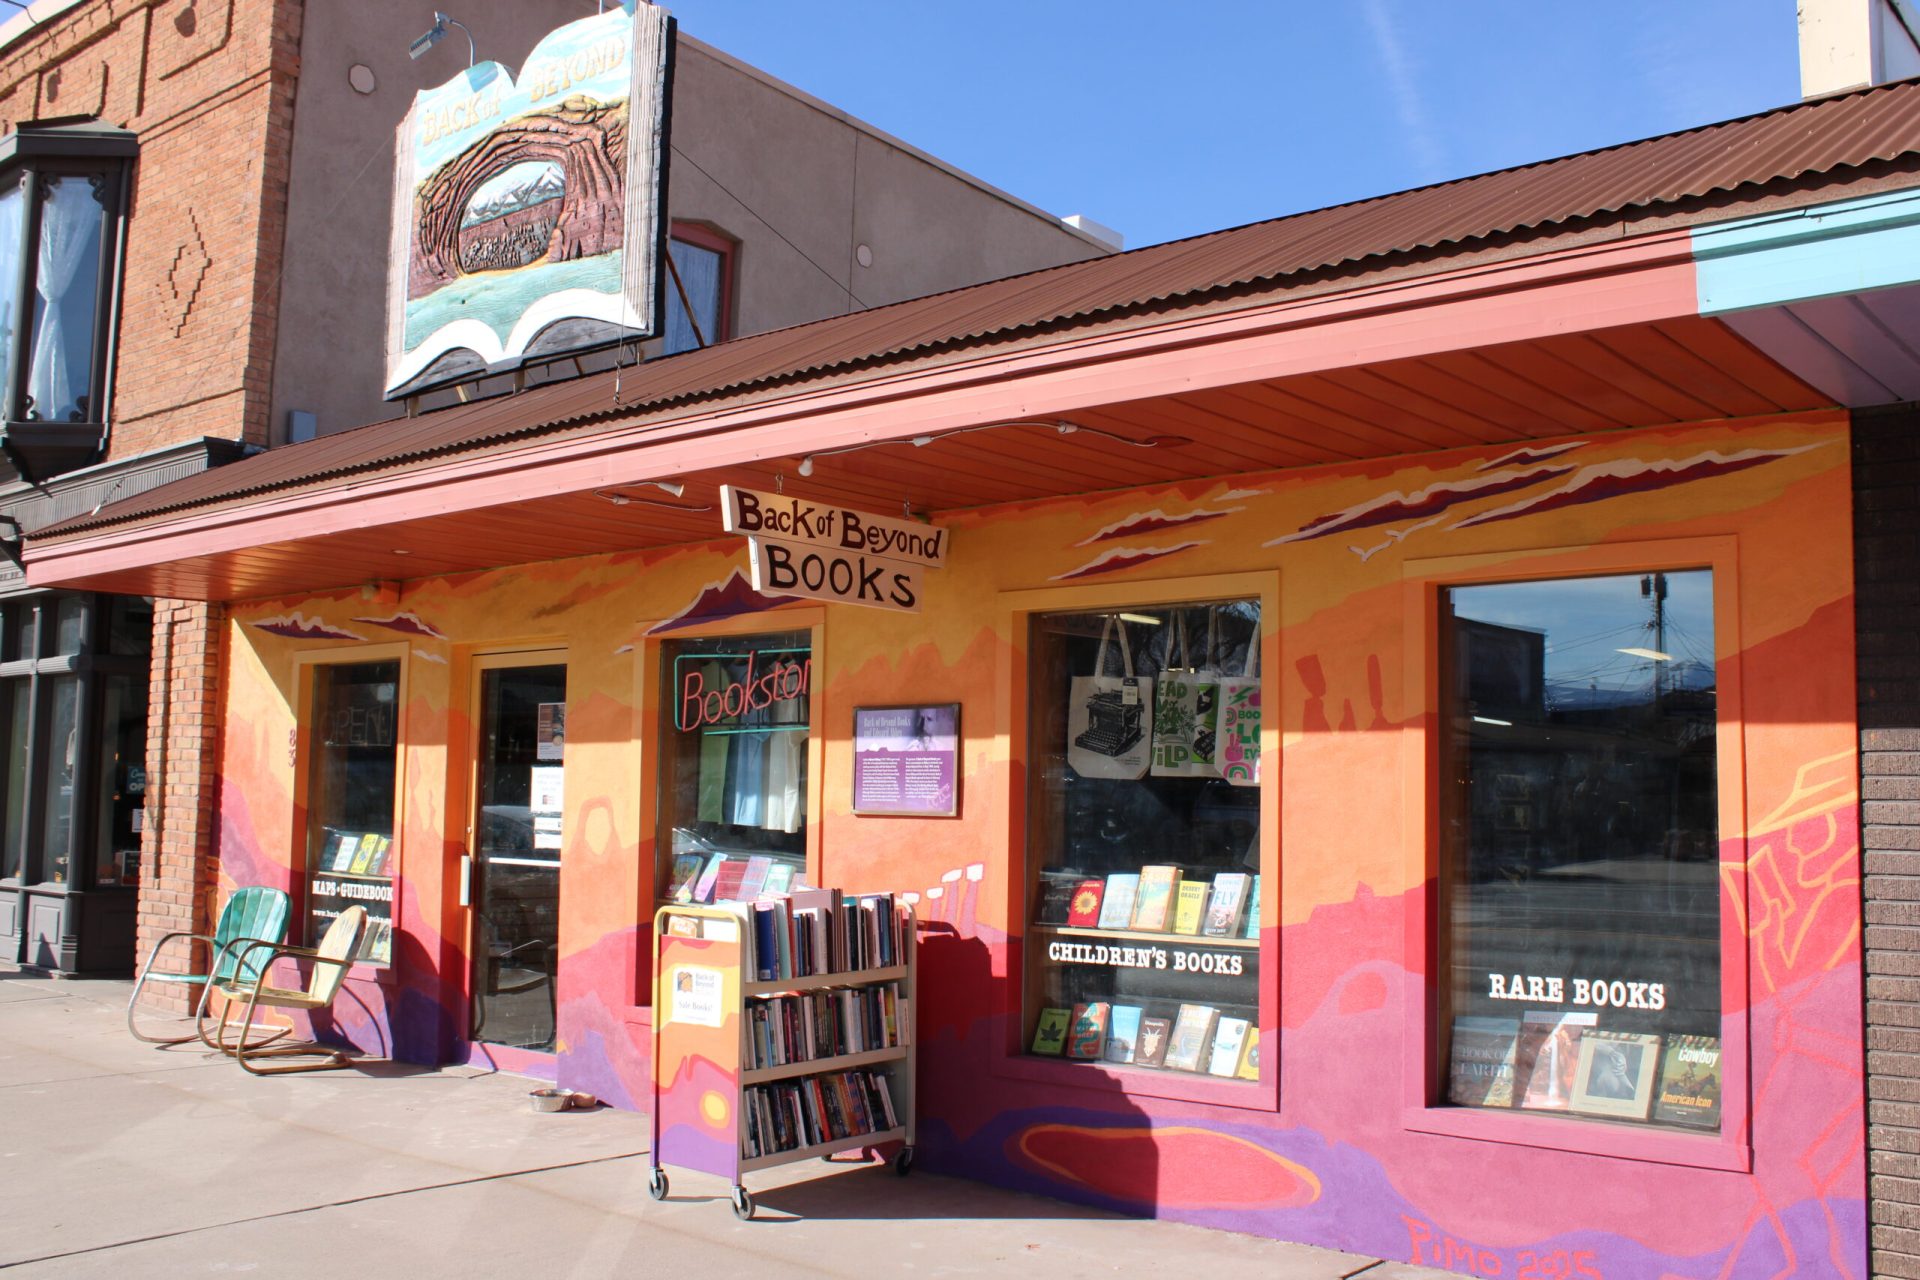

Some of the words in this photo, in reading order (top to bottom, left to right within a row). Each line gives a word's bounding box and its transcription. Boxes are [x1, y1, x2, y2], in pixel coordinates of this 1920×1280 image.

[422, 91, 482, 145] BACK
[484, 85, 502, 120] of
[531, 36, 626, 103] BEYOND
[735, 490, 816, 539] Back
[816, 510, 834, 538] of
[840, 511, 942, 559] Beyond
[312, 880, 336, 896] MAPS
[1214, 891, 1237, 905] FLY
[1048, 942, 1167, 970] CHILDREN'S
[1173, 951, 1243, 976] BOOKS
[1488, 973, 1564, 1003] RARE
[1573, 979, 1667, 1011] BOOKS
[1678, 1047, 1720, 1068] Cowboy
[1660, 1091, 1695, 1107] American
